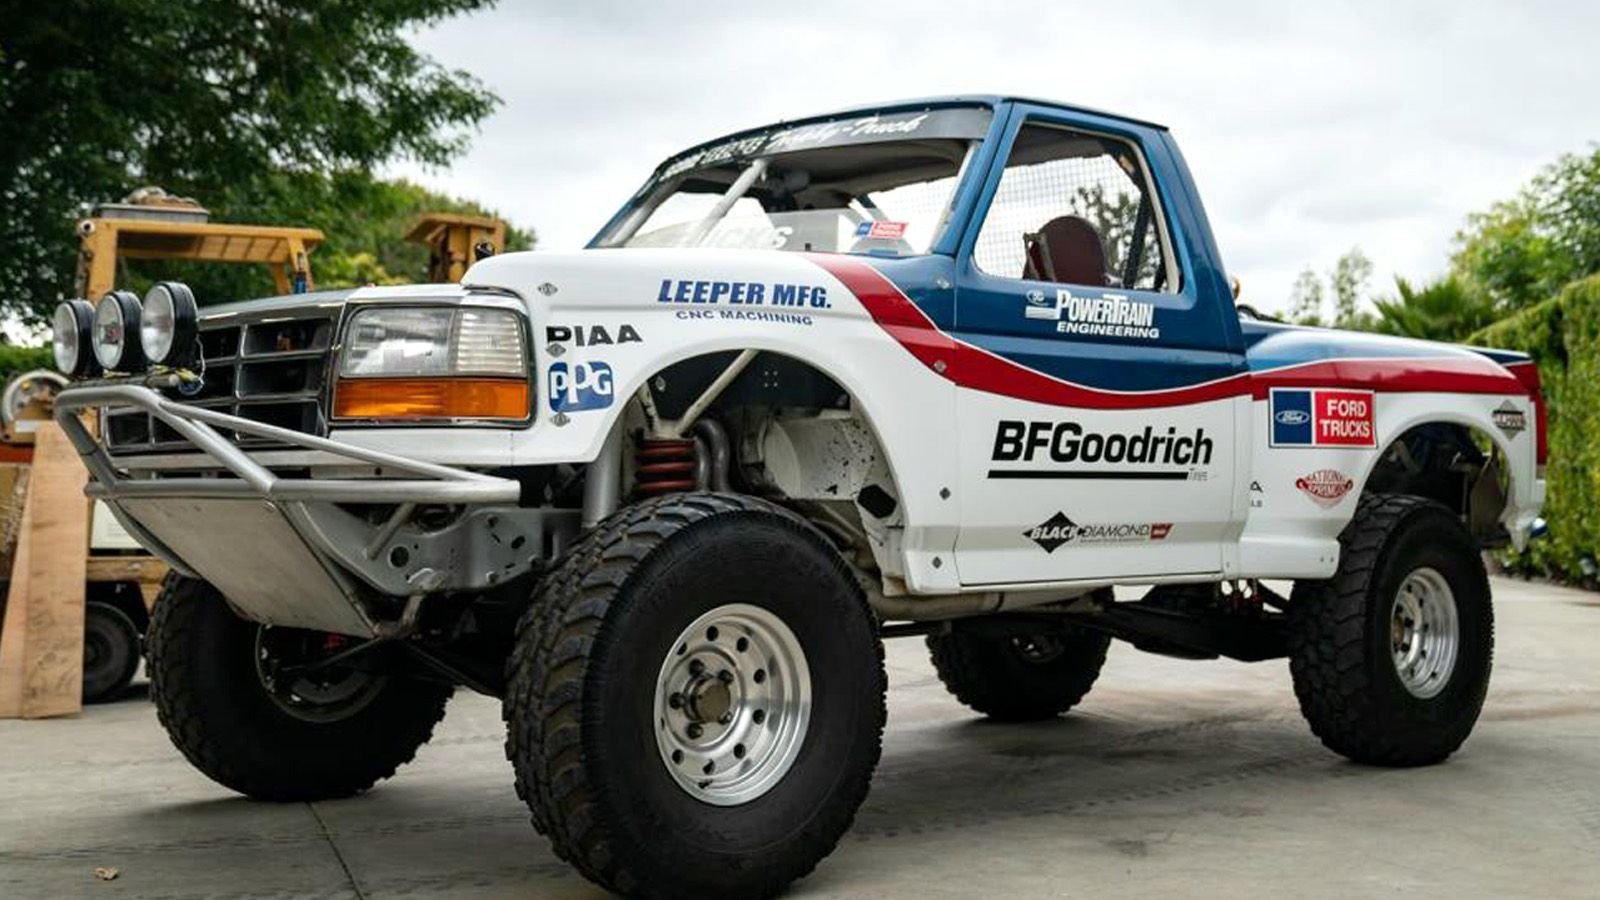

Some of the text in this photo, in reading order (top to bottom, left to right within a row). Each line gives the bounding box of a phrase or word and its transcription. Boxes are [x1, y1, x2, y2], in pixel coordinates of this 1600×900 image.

[657, 279, 832, 309] LEEPER MFG.
[675, 310, 813, 326] CNC MACHINING
[545, 325, 643, 347] PIAA
[1056, 321, 1160, 339] ENGINEERING
[1326, 399, 1367, 417] FORD
[1320, 418, 1371, 437] TRUCKS
[991, 420, 1214, 465] BFGoodrich
[1030, 526, 1080, 540] BLACK
[1081, 524, 1150, 538] DIAMOND
